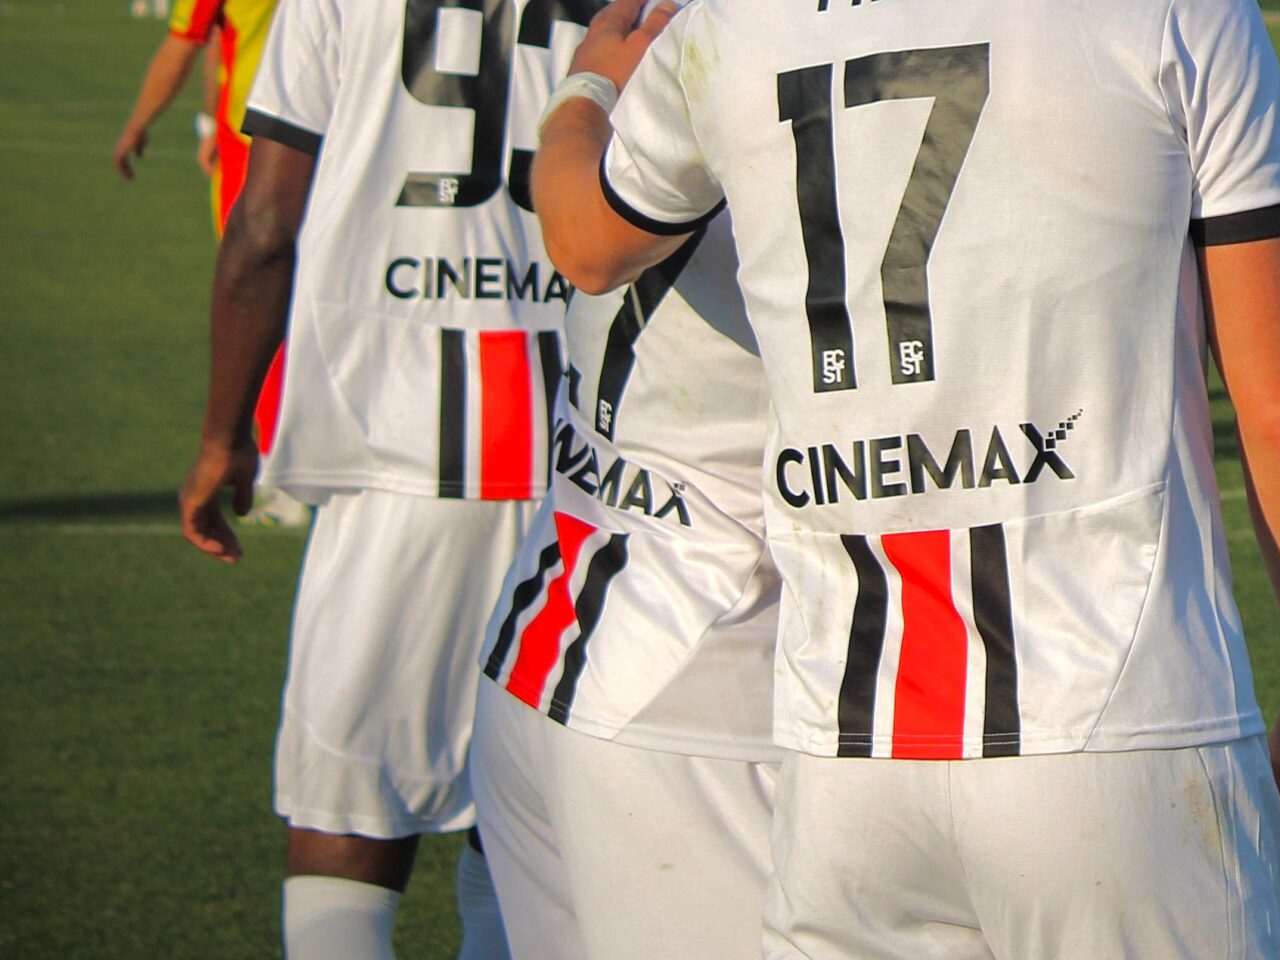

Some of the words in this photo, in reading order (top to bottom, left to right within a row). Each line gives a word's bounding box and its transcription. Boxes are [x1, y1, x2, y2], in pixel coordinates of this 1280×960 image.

[777, 43, 990, 393] 17
[386, 256, 569, 303] CINEMA
[776, 422, 1077, 508] CINEMAX
